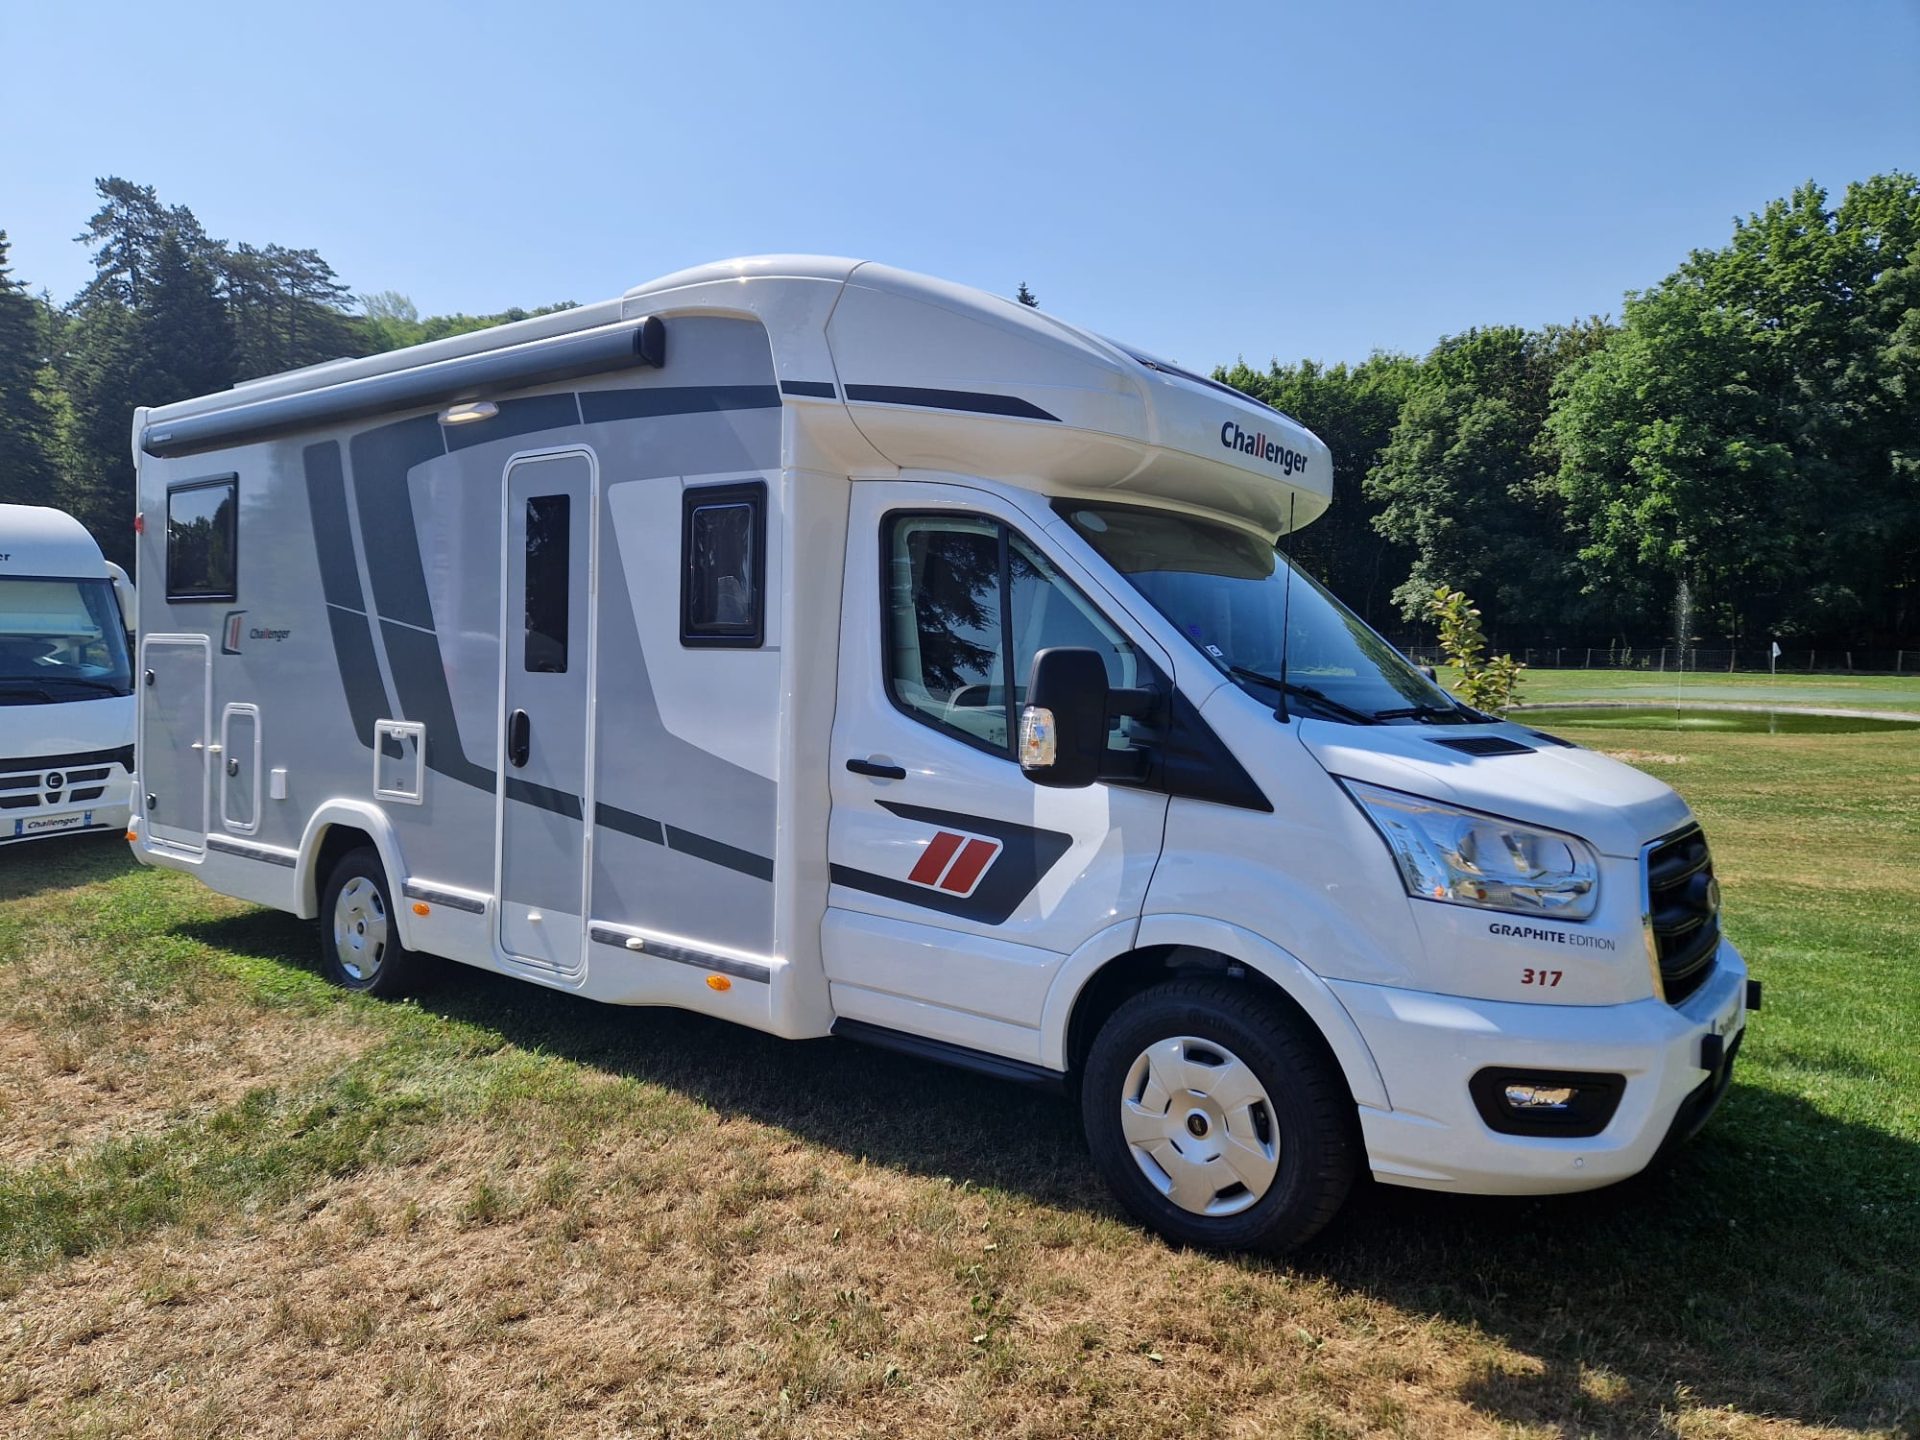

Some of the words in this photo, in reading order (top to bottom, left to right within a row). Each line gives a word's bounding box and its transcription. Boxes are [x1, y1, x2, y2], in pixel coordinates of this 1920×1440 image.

[1220, 421, 1308, 476] Challenger
[249, 628, 291, 642] Challenger
[27, 816, 80, 829] Challenger
[1489, 923, 1566, 944] GRAPHITE
[1569, 933, 1616, 951] EDITION
[1521, 968, 1562, 987] 317
